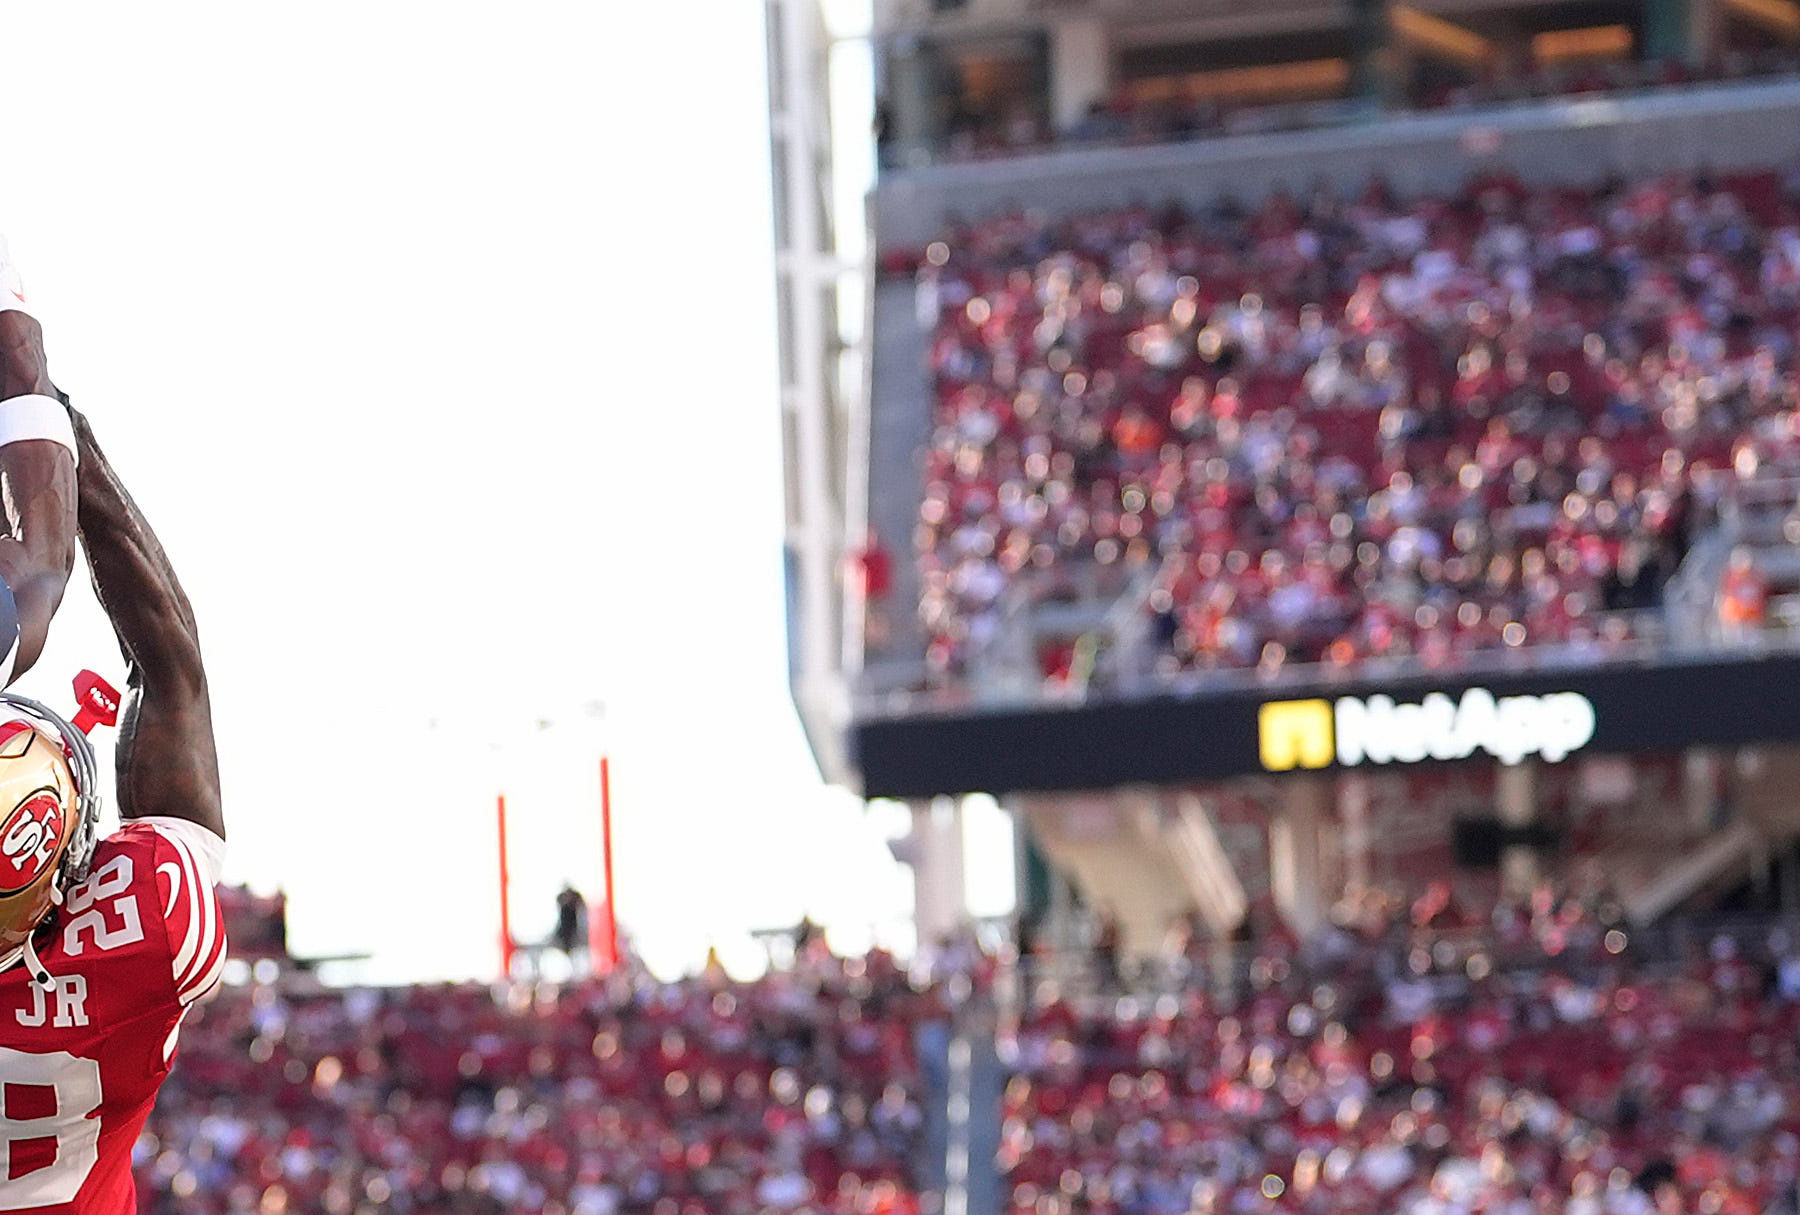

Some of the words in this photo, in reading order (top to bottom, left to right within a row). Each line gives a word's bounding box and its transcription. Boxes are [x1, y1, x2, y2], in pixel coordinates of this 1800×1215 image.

[1334, 687, 1596, 766] NetApp
[62, 854, 145, 957] 28
[15, 974, 90, 1028] JR
